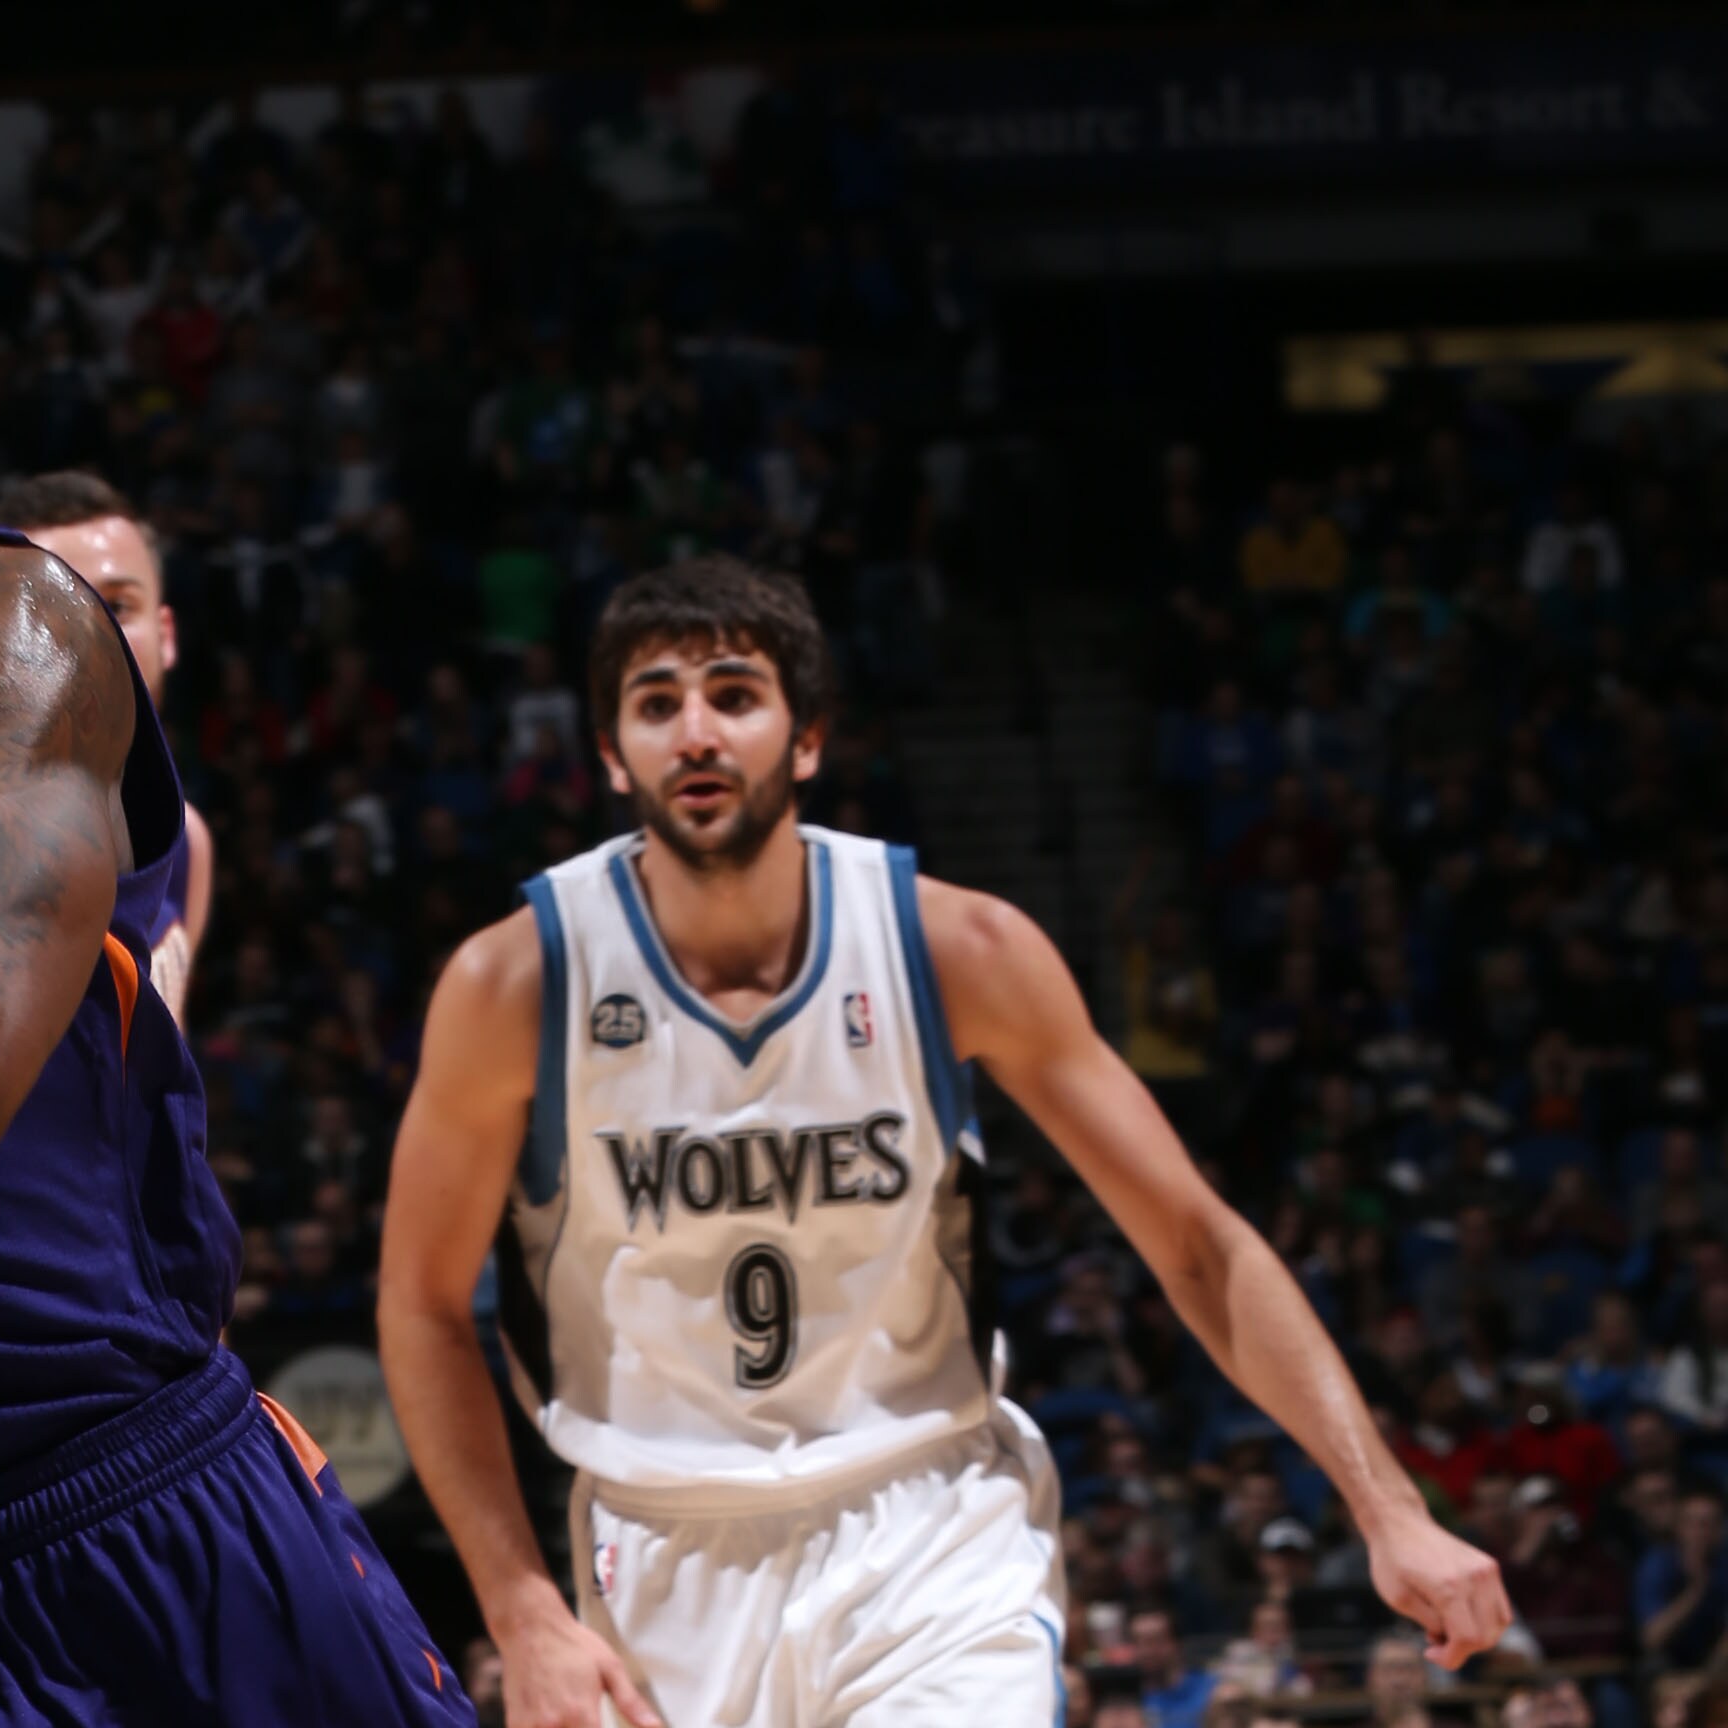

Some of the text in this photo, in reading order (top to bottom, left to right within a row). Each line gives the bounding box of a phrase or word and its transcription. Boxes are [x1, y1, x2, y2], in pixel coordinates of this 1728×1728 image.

[1156, 68, 1378, 151] Island
[1396, 70, 1628, 142] Resort
[1644, 64, 1714, 132] &
[595, 1001, 643, 1037] 25
[594, 1110, 910, 1234] WOLVES
[724, 1243, 799, 1390] 9
